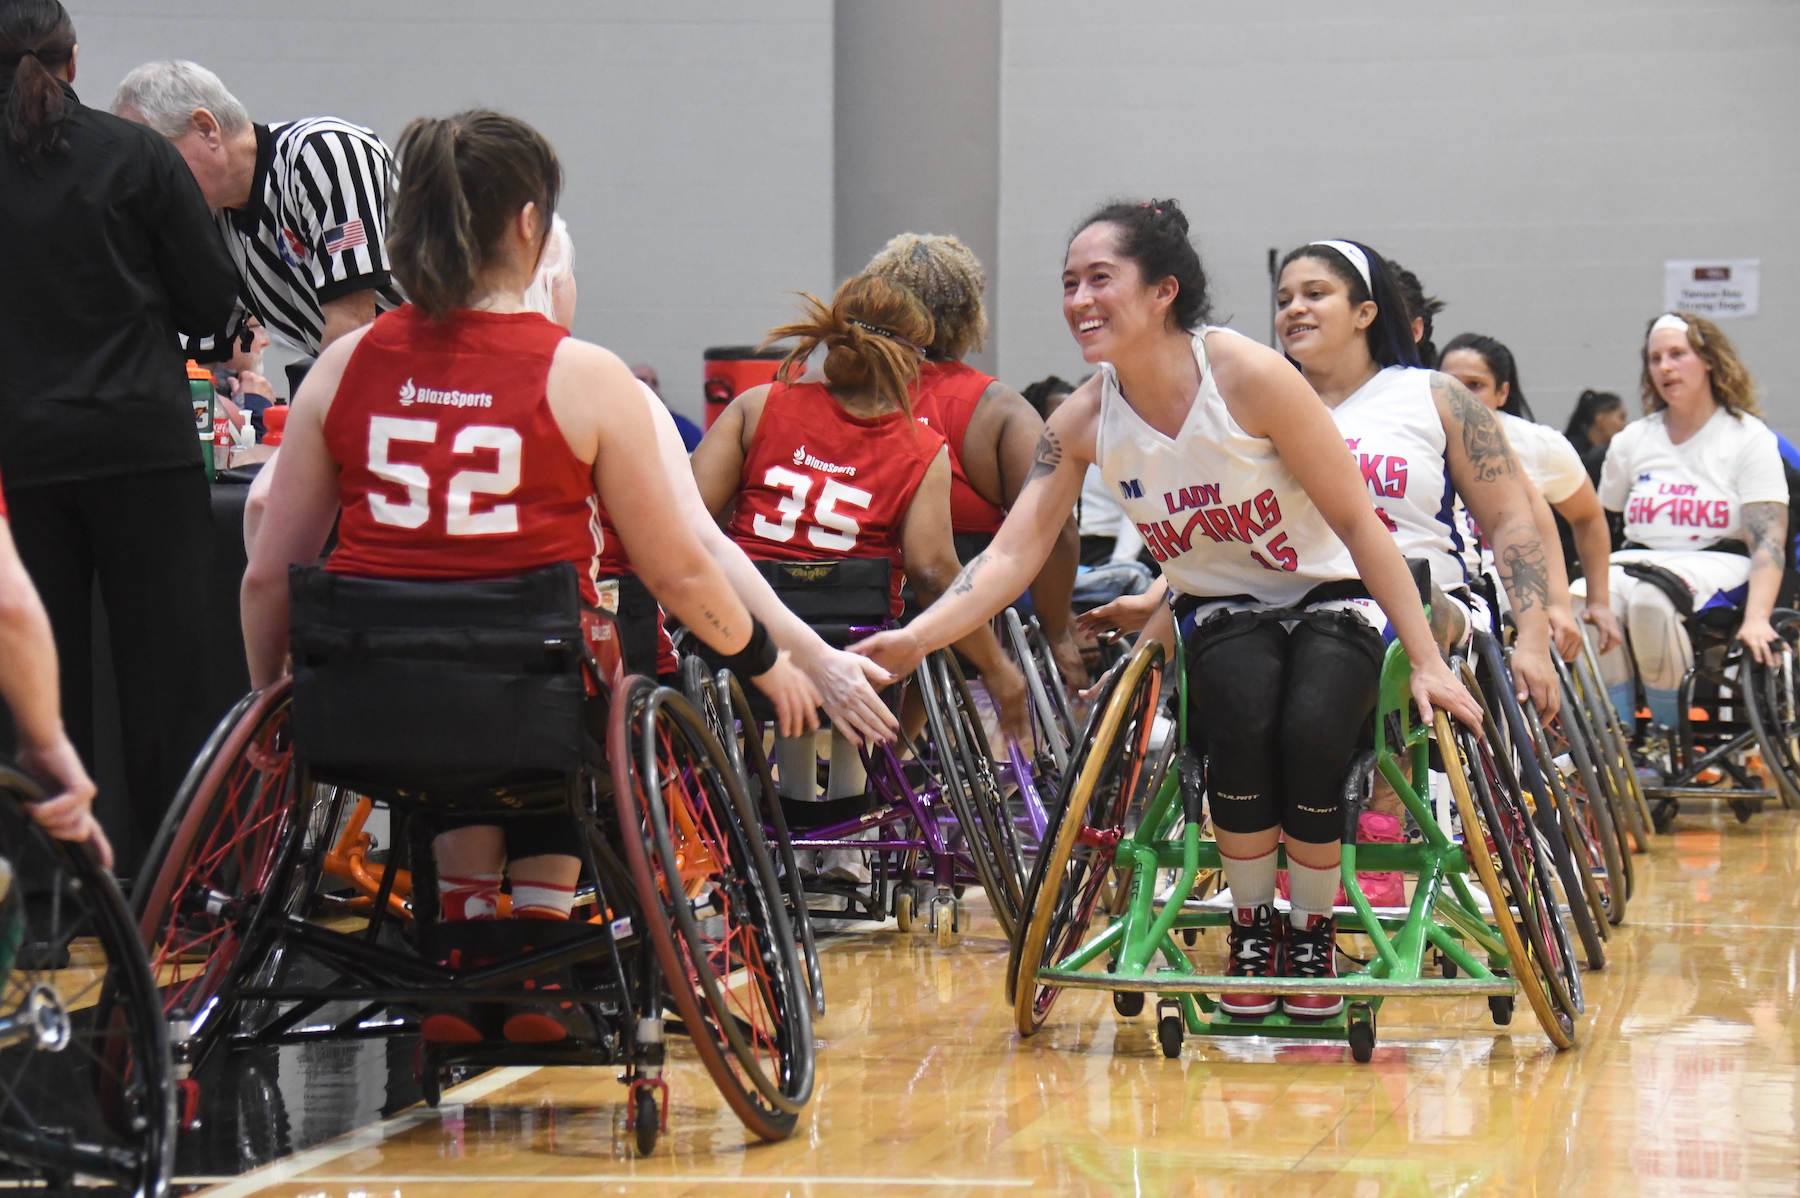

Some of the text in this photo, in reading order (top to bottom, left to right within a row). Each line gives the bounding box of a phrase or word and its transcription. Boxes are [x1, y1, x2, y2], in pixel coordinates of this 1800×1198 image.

[417, 387, 493, 408] BlazeSports
[367, 414, 523, 536] 52
[804, 454, 857, 477] BlazeSports
[1163, 483, 1222, 515] LADY
[1658, 484, 1698, 496] LADY
[752, 464, 873, 552] 35
[1628, 497, 1729, 529] SHARKS
[1137, 488, 1282, 563] SHARKS
[1250, 531, 1298, 572] 15
